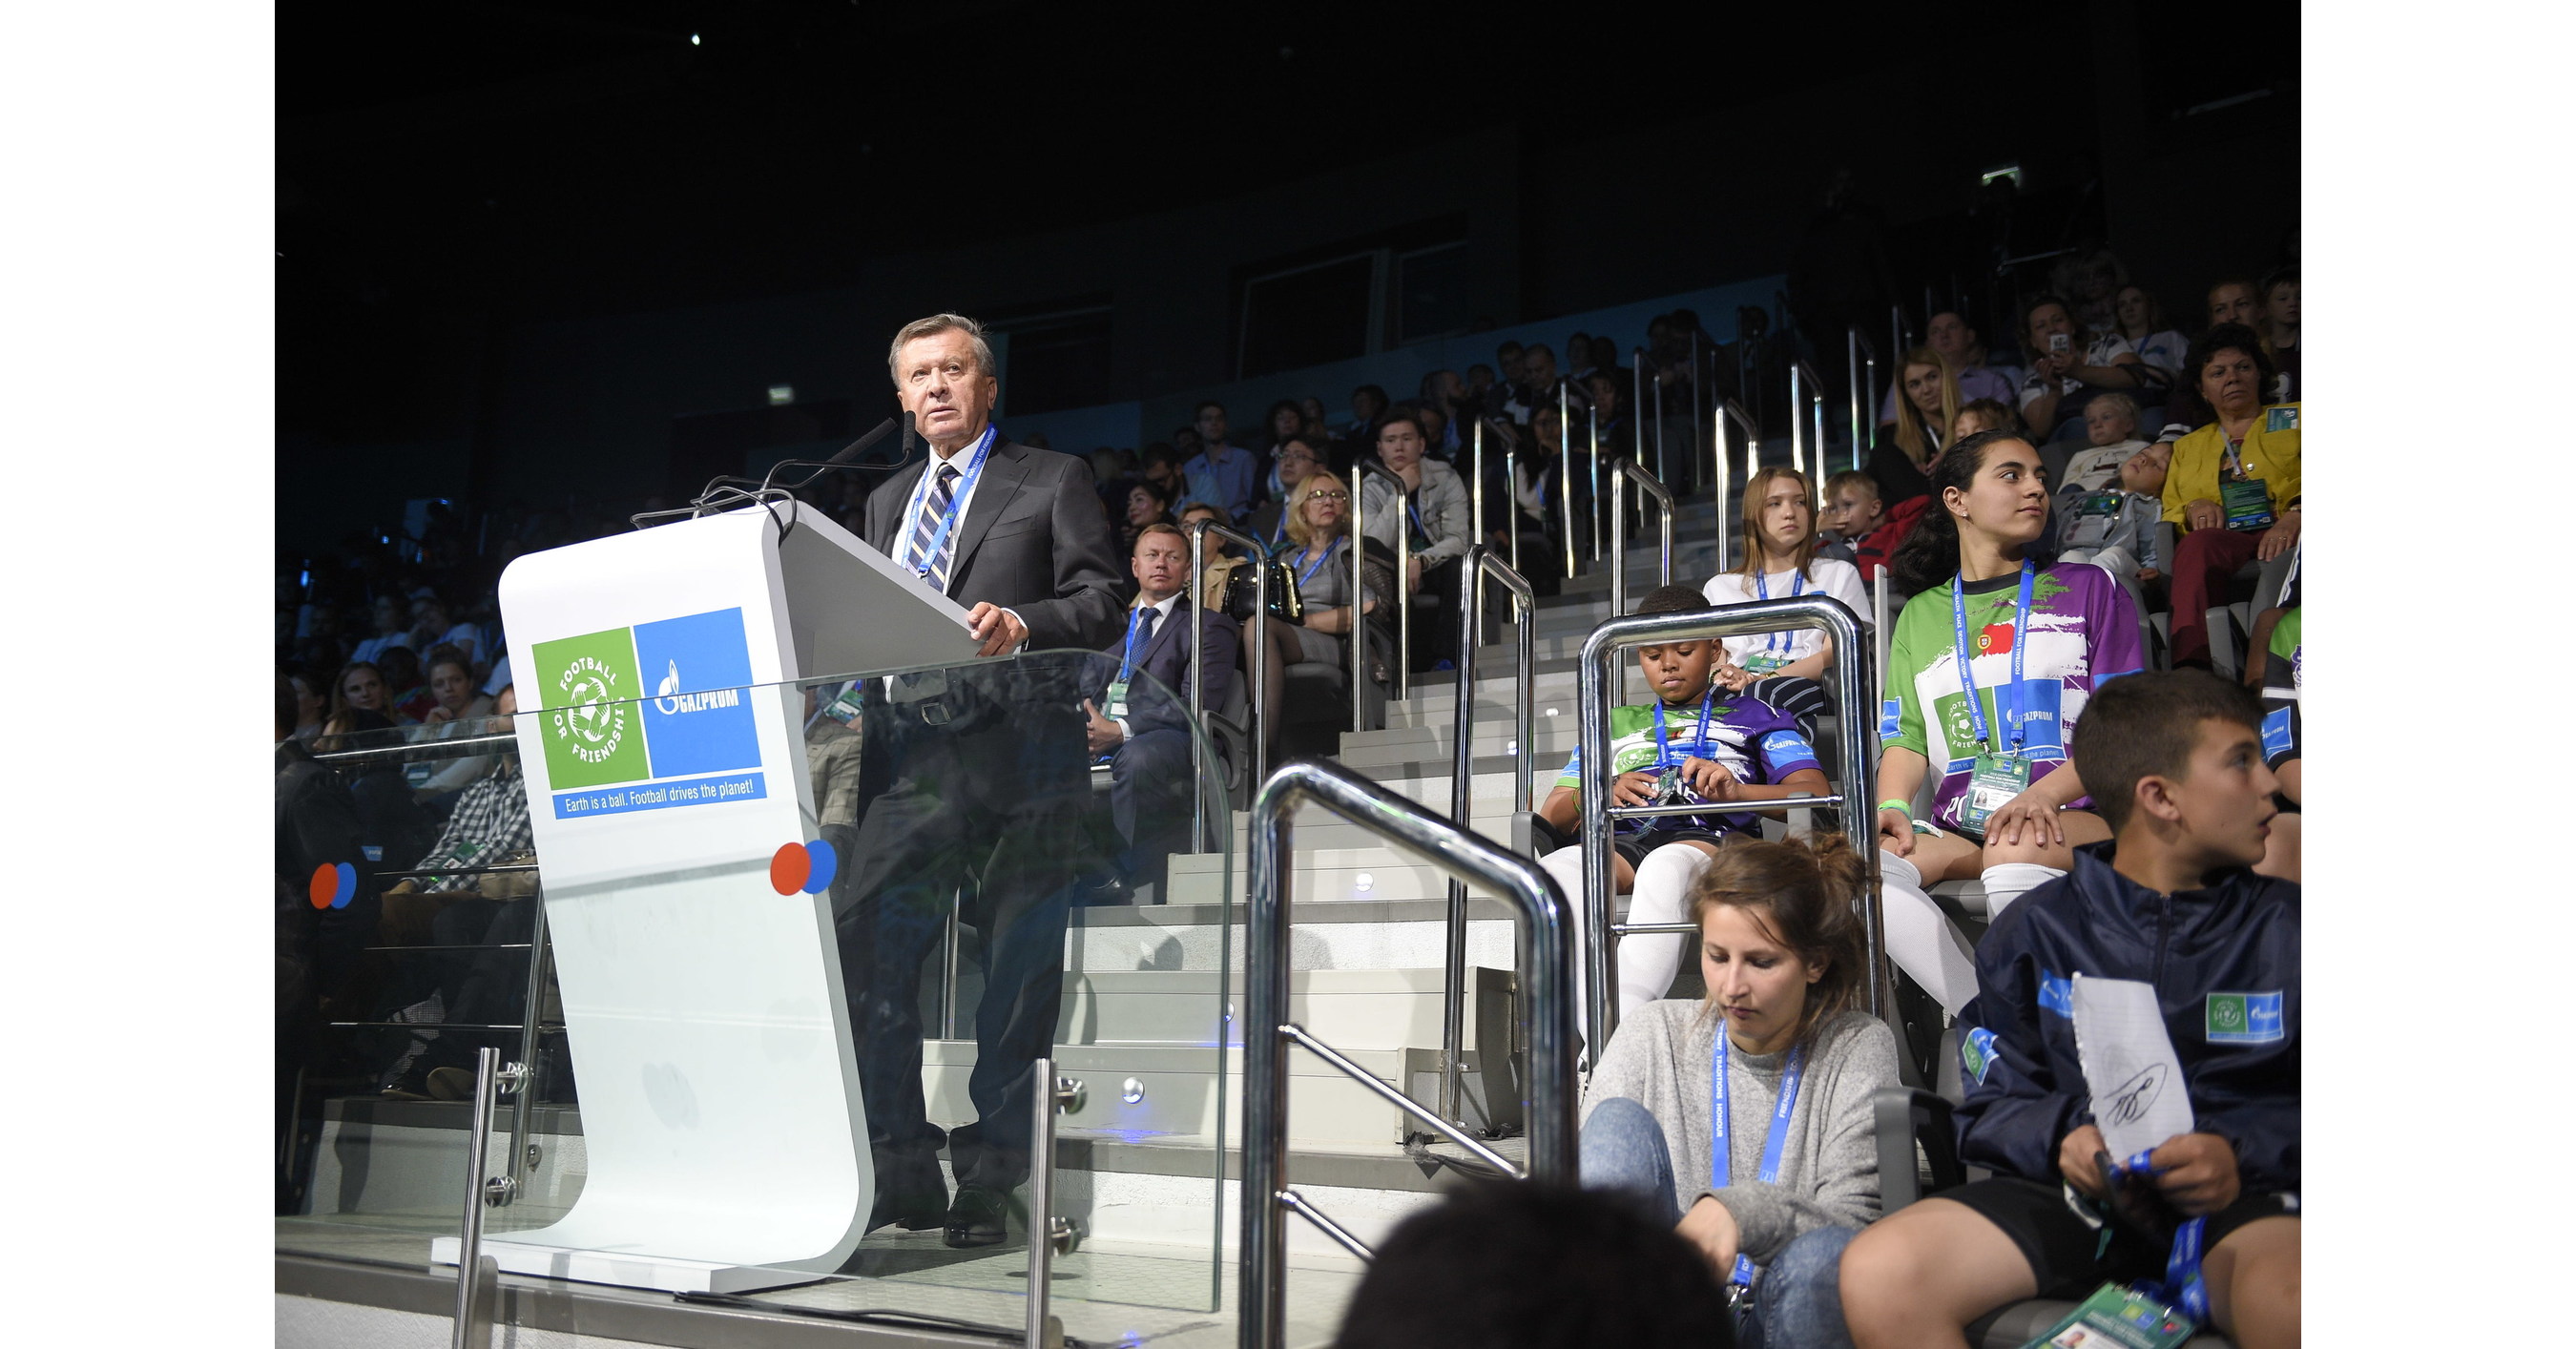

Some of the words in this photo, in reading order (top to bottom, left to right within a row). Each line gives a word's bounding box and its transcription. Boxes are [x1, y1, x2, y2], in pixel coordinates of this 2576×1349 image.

[559, 656, 617, 692] FOOTBALL
[1960, 657, 1968, 679] VICTORY
[1964, 681, 1977, 714] TRADITIONS
[677, 689, 739, 714] GAZPROM
[565, 797, 590, 812] Earth
[591, 796, 599, 809] is
[601, 798, 608, 808] a
[608, 793, 629, 808] ball.
[630, 787, 667, 805] Football
[669, 786, 699, 801] drives
[700, 783, 717, 799] the
[718, 778, 755, 799] planet!
